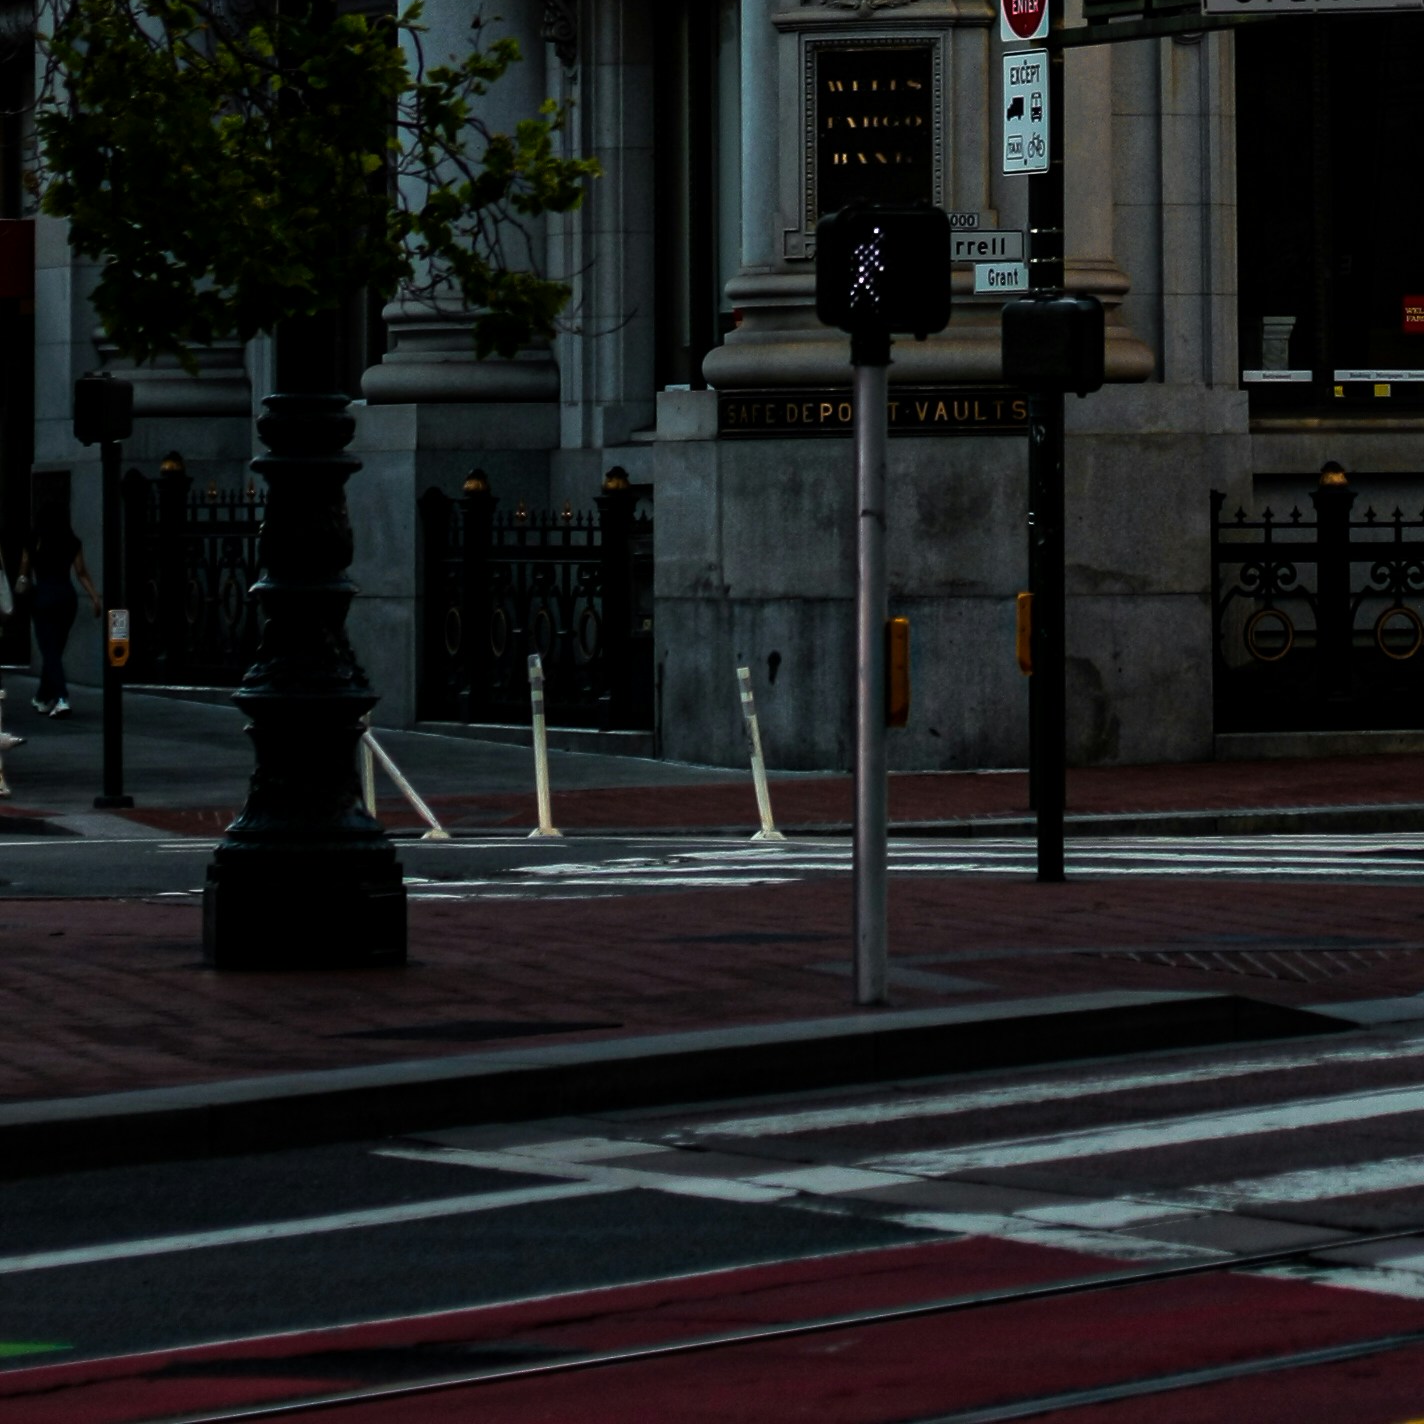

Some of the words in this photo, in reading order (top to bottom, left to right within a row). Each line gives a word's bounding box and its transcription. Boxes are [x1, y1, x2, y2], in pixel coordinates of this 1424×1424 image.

[1009, 64, 1041, 88] EXCEPT
[956, 237, 1005, 255] rrell
[988, 268, 1018, 286] Grant
[726, 403, 776, 424] SAFE
[785, 401, 900, 424] DEPOT
[913, 400, 1029, 423] VAULTS
